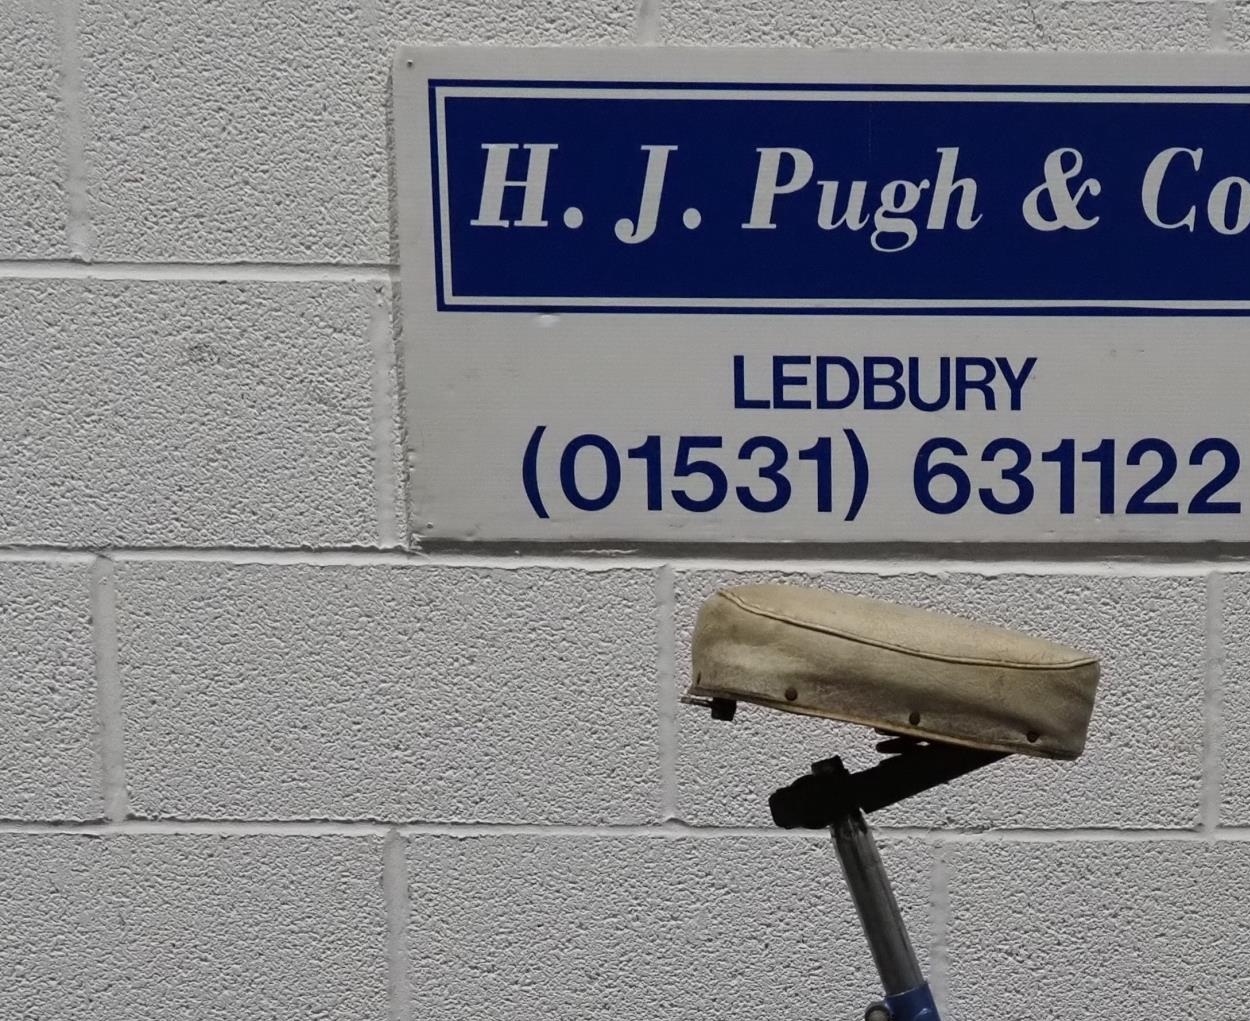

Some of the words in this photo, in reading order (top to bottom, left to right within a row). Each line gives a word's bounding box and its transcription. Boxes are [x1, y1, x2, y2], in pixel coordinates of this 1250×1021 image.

[470, 142, 583, 229] H.
[613, 144, 702, 244] J.
[741, 146, 982, 252] Pugh
[1021, 147, 1102, 232] &
[733, 354, 1038, 412] LEDBURY
[521, 425, 870, 521] (01531)
[912, 436, 1242, 515] 631122
